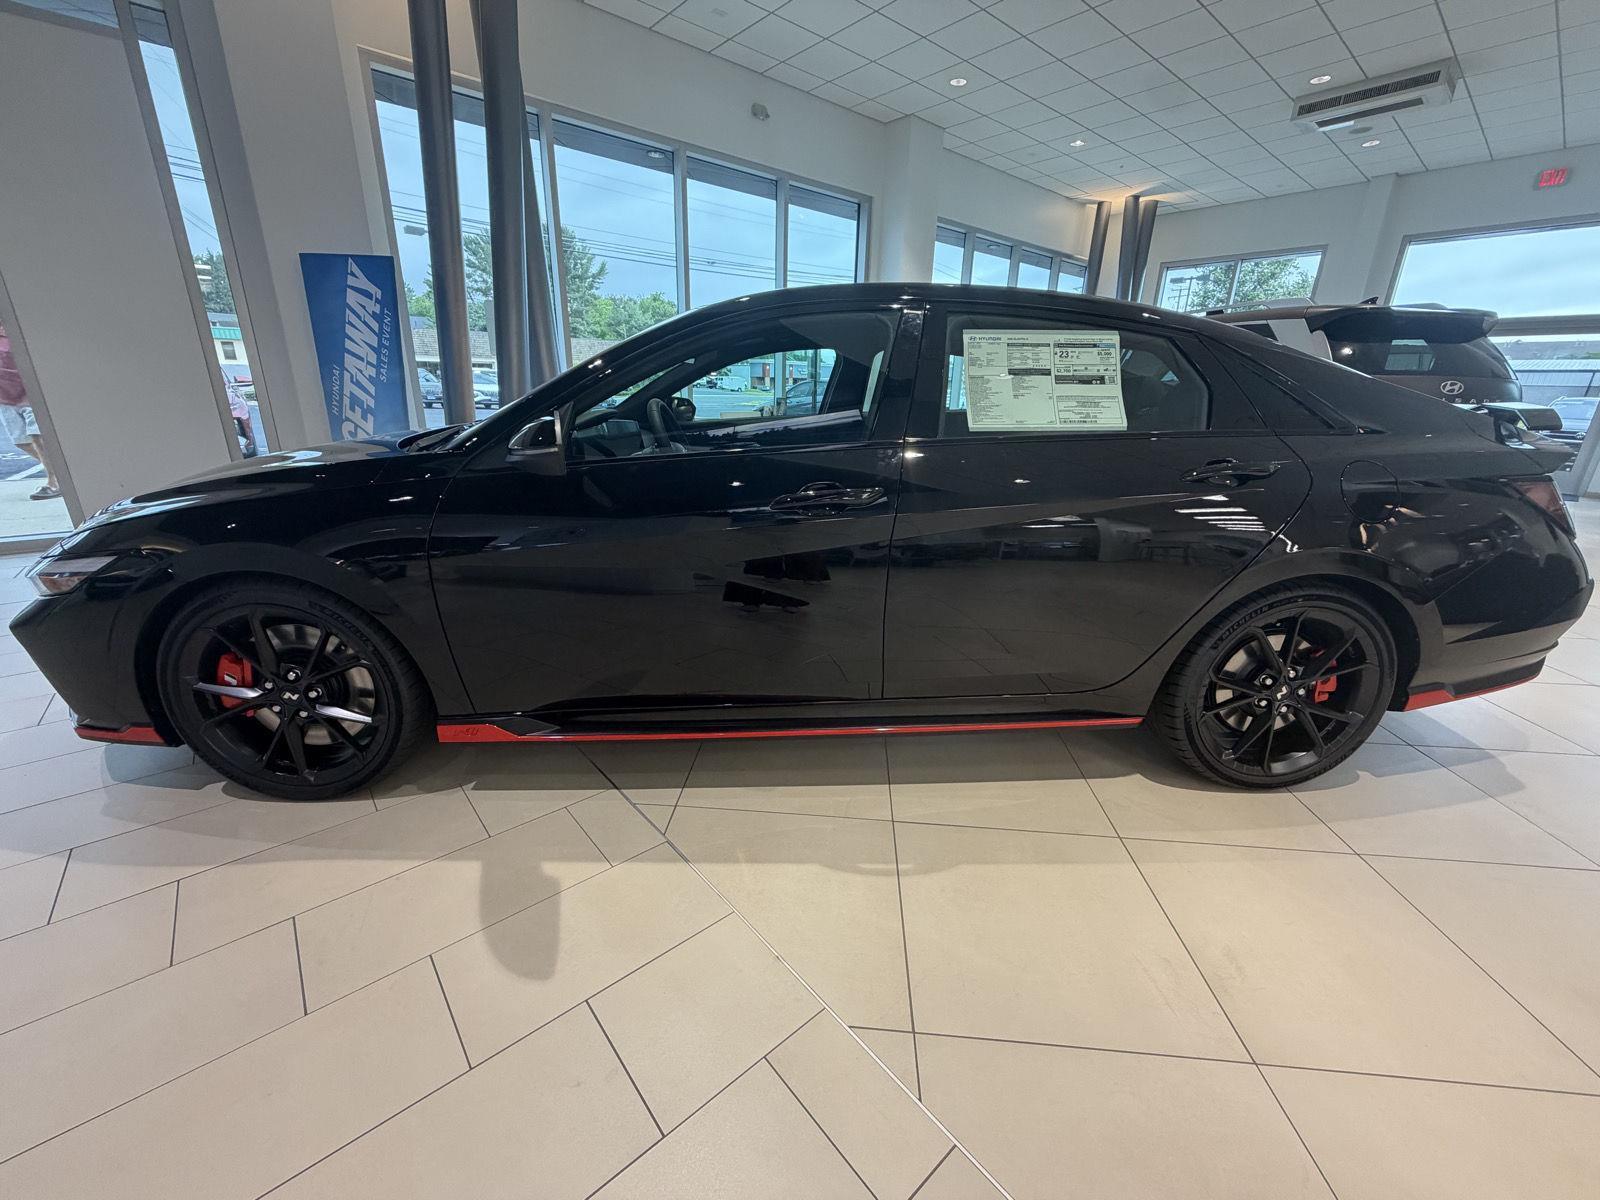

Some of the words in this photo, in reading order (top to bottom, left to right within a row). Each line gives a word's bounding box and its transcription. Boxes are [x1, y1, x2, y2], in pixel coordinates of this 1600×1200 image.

[382, 307, 392, 346] EVENT
[379, 348, 388, 383] SALES
[1059, 350, 1070, 359] 23
[331, 364, 340, 416] HYUNDAI
